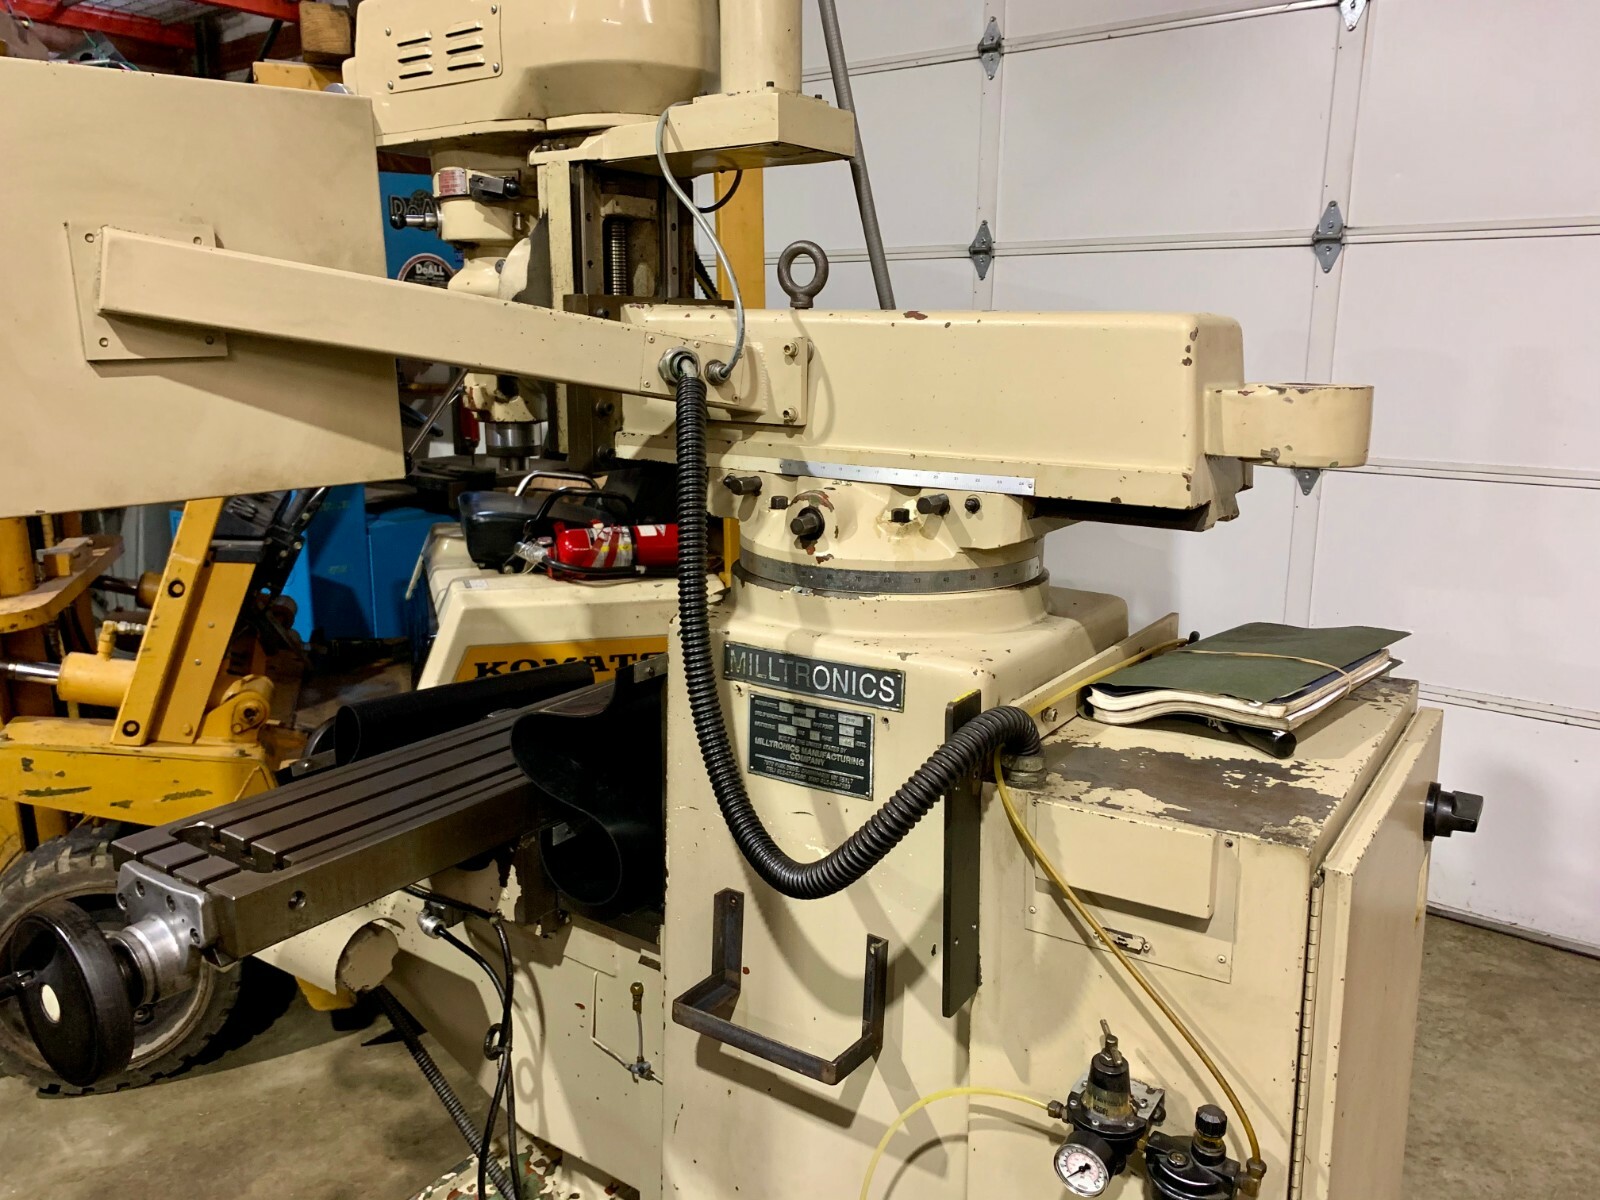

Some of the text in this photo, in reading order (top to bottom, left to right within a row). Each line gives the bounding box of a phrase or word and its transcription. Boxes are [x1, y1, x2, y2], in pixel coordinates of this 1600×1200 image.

[415, 263, 445, 275] DoALL
[474, 652, 668, 678] KOAT
[730, 649, 895, 702] MILLTRONICS
[754, 736, 800, 752] MILLTRONICS
[801, 747, 865, 767] MANUFACTURING
[789, 753, 825, 766] COMPANY
